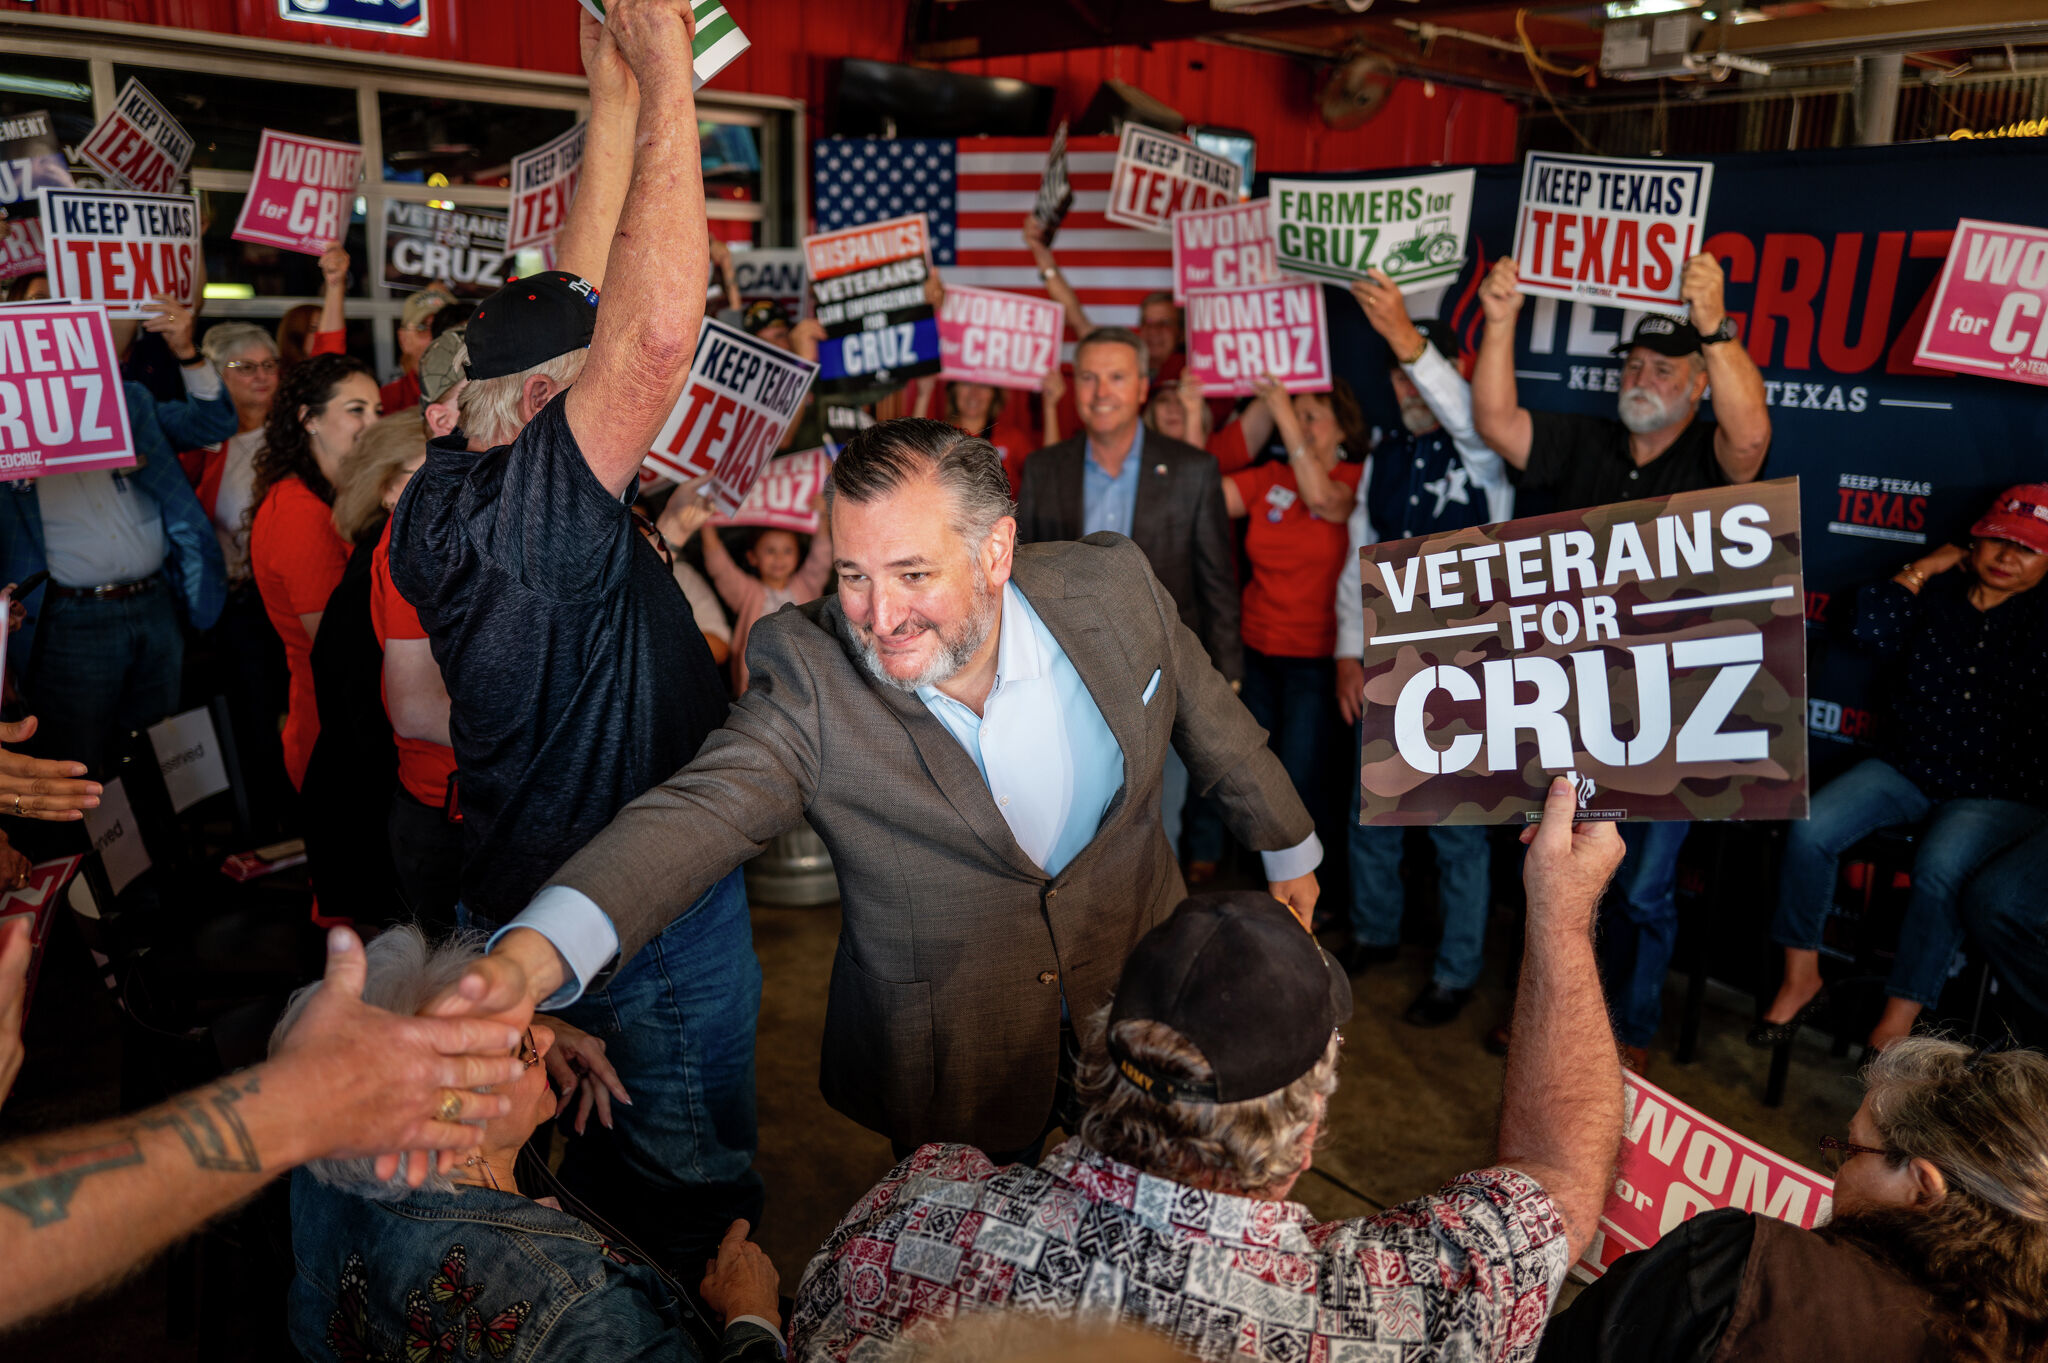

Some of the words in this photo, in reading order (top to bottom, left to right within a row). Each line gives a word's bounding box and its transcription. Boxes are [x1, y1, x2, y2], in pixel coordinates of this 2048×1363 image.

[123, 94, 160, 132] KEEP
[154, 122, 186, 164] TEXAS
[96, 116, 175, 193] TEXAS
[1132, 136, 1180, 169] KEEP
[1183, 152, 1232, 190] TEXAS
[258, 198, 288, 220] for
[1129, 166, 1230, 220] TEXA
[1279, 187, 1424, 224] FARMERS
[1427, 192, 1456, 214] for
[1536, 166, 1592, 209] KEEP
[1597, 173, 1685, 216] TEXAS
[62, 200, 130, 235] KEEP
[133, 204, 192, 239] TEXAS
[391, 203, 508, 241] VETERANS
[392, 239, 504, 288] CRUZ
[811, 223, 922, 271] HISPANICS
[1278, 222, 1380, 271] CRUZ
[1532, 209, 1677, 292] TEXAS
[66, 241, 192, 302] TEXAS
[813, 256, 927, 304] VETERANS
[941, 292, 1055, 335] WOMEN
[1191, 285, 1312, 332] WOMEN
[1948, 307, 1989, 335] for
[842, 322, 919, 376] CRUZ
[961, 326, 1054, 375] CRUZ
[1212, 326, 1317, 379] CRUZ
[700, 337, 761, 395] KEEP
[754, 361, 804, 417] TEXAS
[1764, 382, 1869, 414] TEXAS
[666, 382, 780, 497] TEXAS
[1837, 486, 1927, 531] TEXAS
[1839, 472, 1879, 491] KEEP
[1880, 477, 1932, 497] TEXAS
[1376, 504, 1774, 614] VETERANS
[1508, 595, 1621, 650] FOR
[1394, 631, 1770, 775] CRUZ
[1120, 1059, 1155, 1092] ARMY
